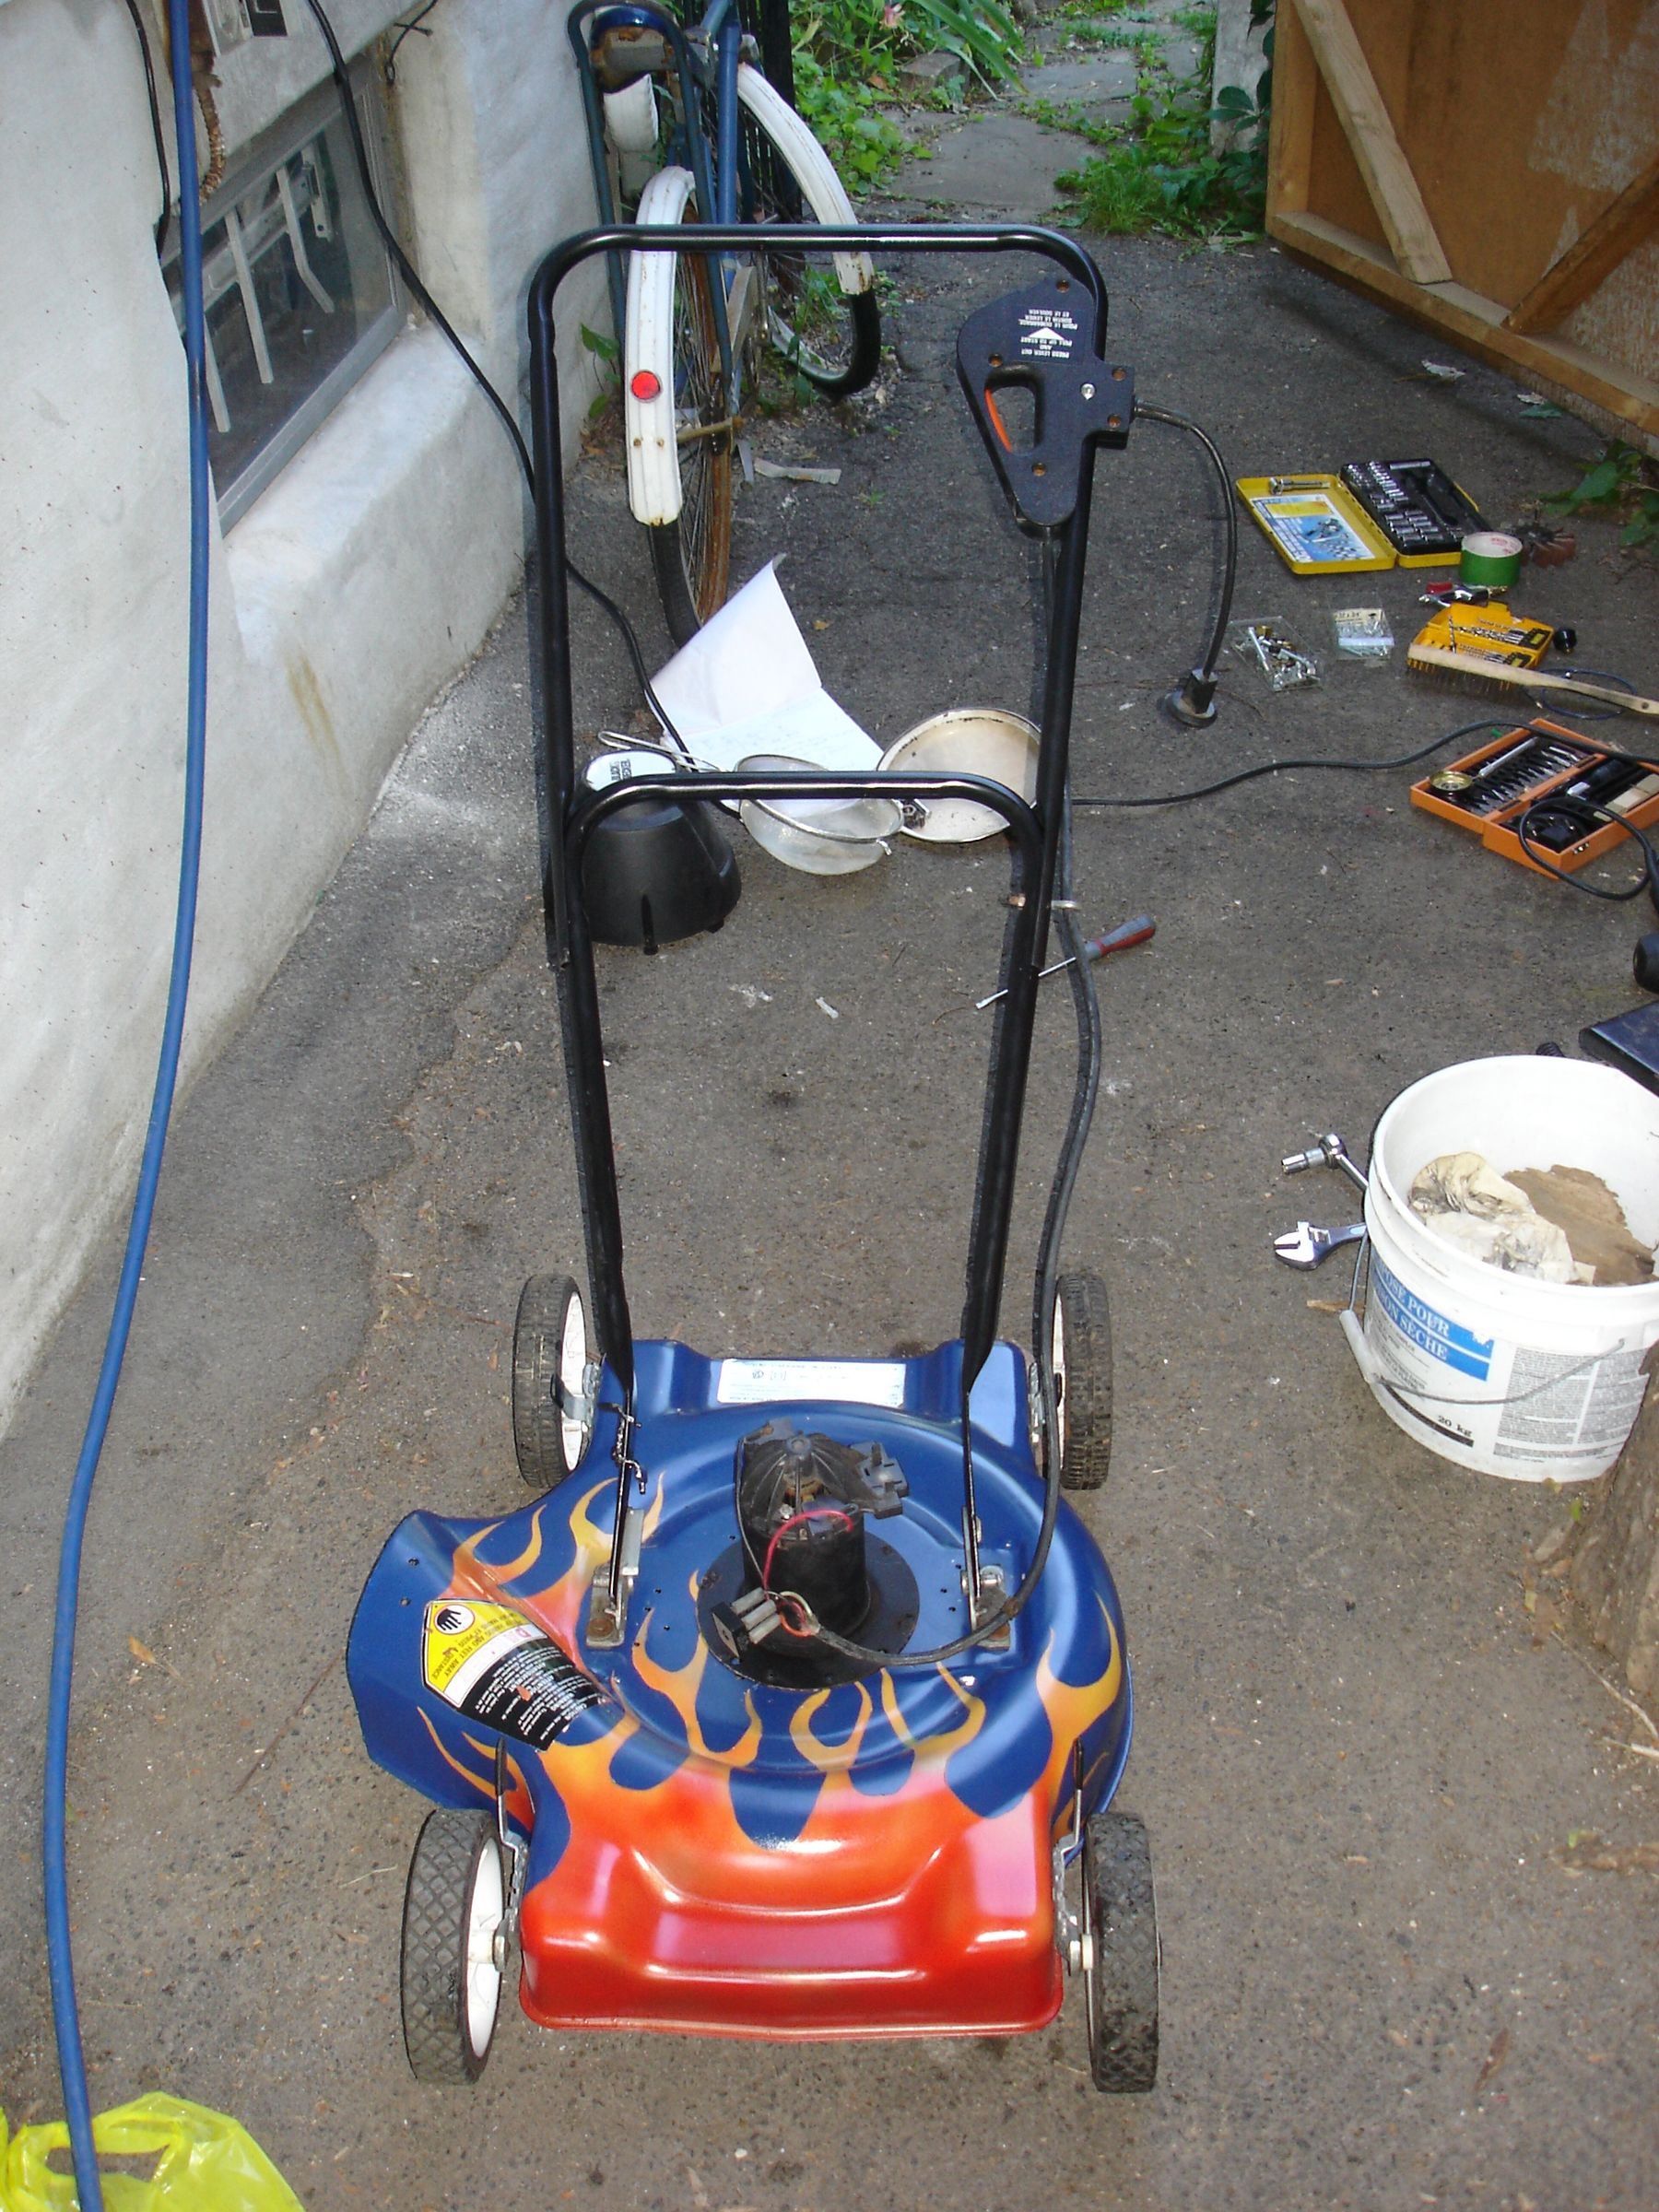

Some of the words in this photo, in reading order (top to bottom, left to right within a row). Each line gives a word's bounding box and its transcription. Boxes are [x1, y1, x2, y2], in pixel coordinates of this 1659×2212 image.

[1407, 1294, 1449, 1337] POUR
[1438, 1414, 1453, 1428] 20
[1457, 1424, 1472, 1438] kg
